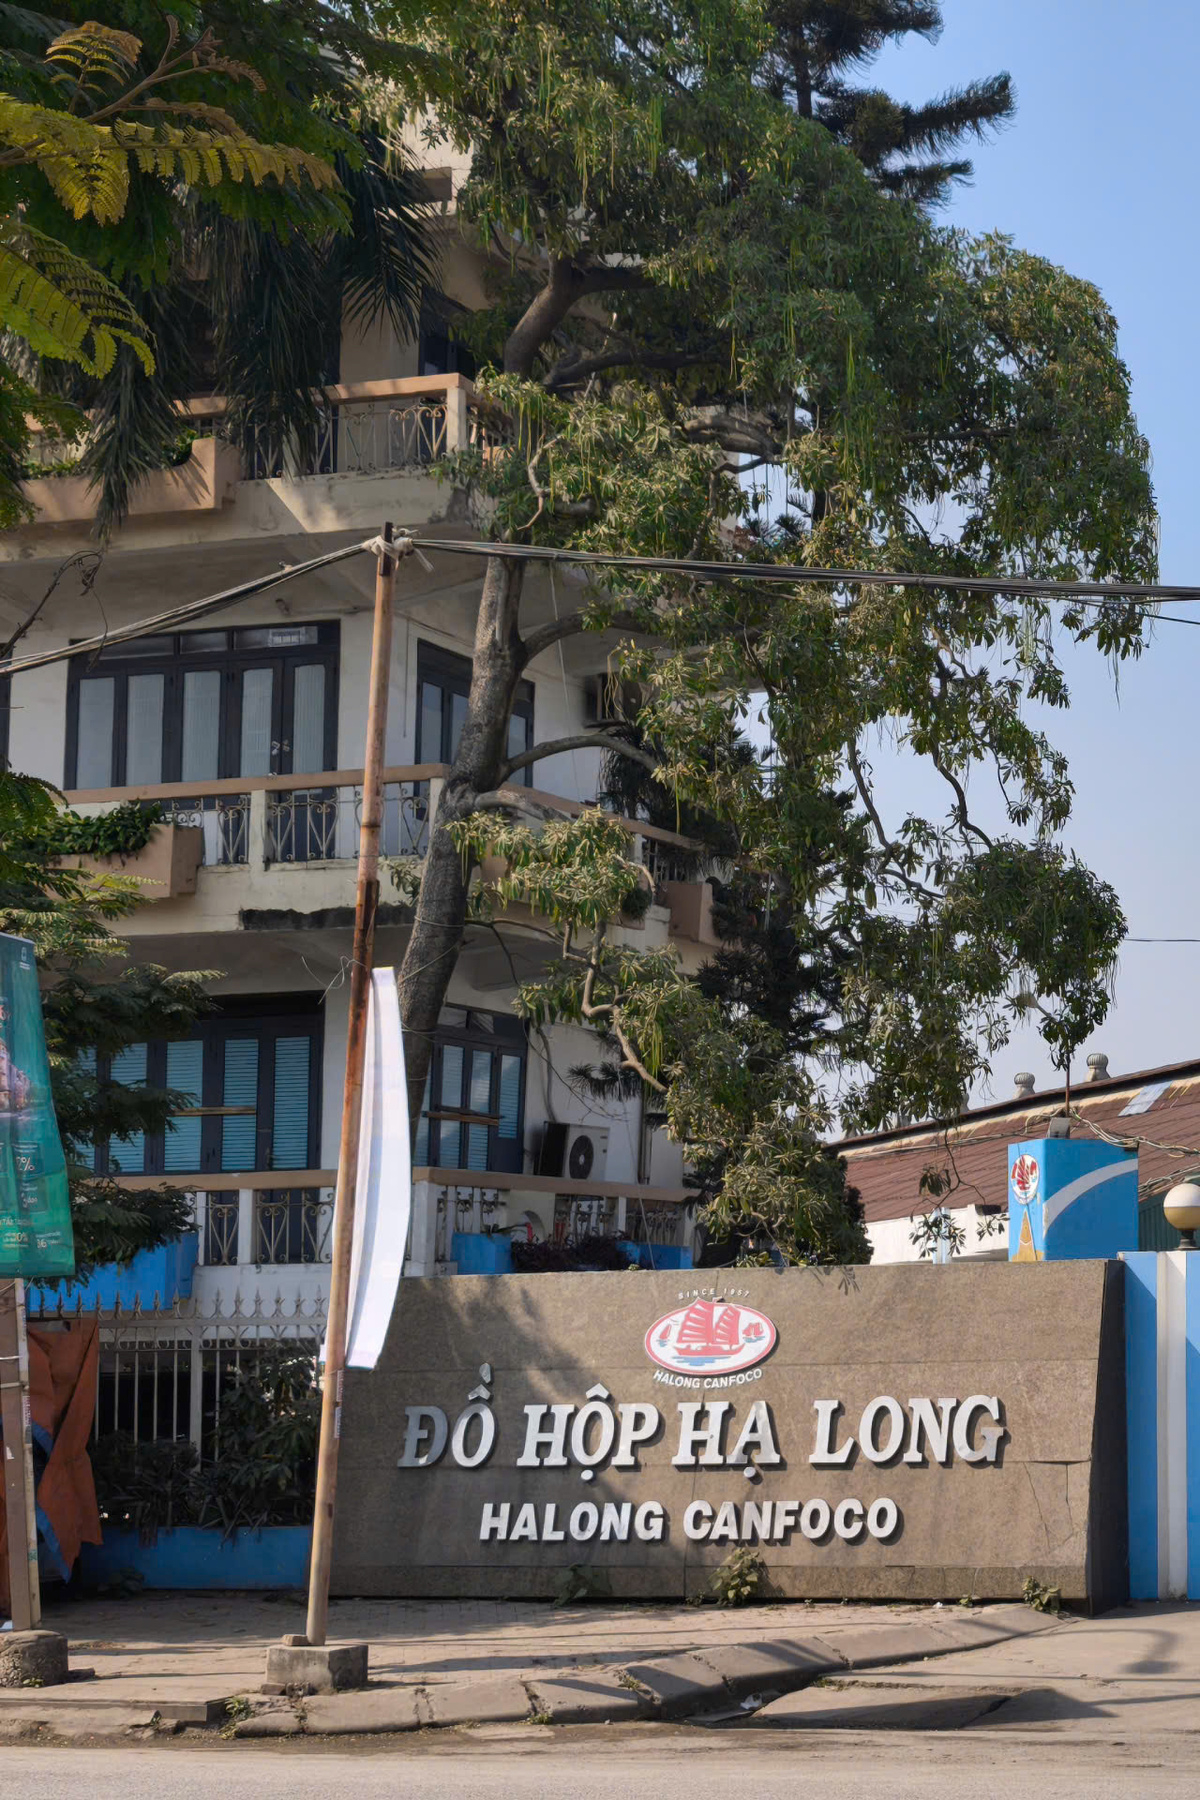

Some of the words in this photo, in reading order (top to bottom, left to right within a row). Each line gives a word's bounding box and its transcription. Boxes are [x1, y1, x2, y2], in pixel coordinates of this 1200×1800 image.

[678, 1288, 716, 1300] SINCE
[723, 1288, 750, 1298] 1957
[653, 1369, 700, 1388] HALONG
[703, 1368, 763, 1389] CANFOCO
[397, 1362, 496, 1468] ĐỒ
[516, 1383, 660, 1481] HỘP
[671, 1400, 781, 1478] HẠ
[808, 1394, 1005, 1463] LONG
[479, 1500, 665, 1541] HALONG
[683, 1498, 898, 1540] CANFOCO
